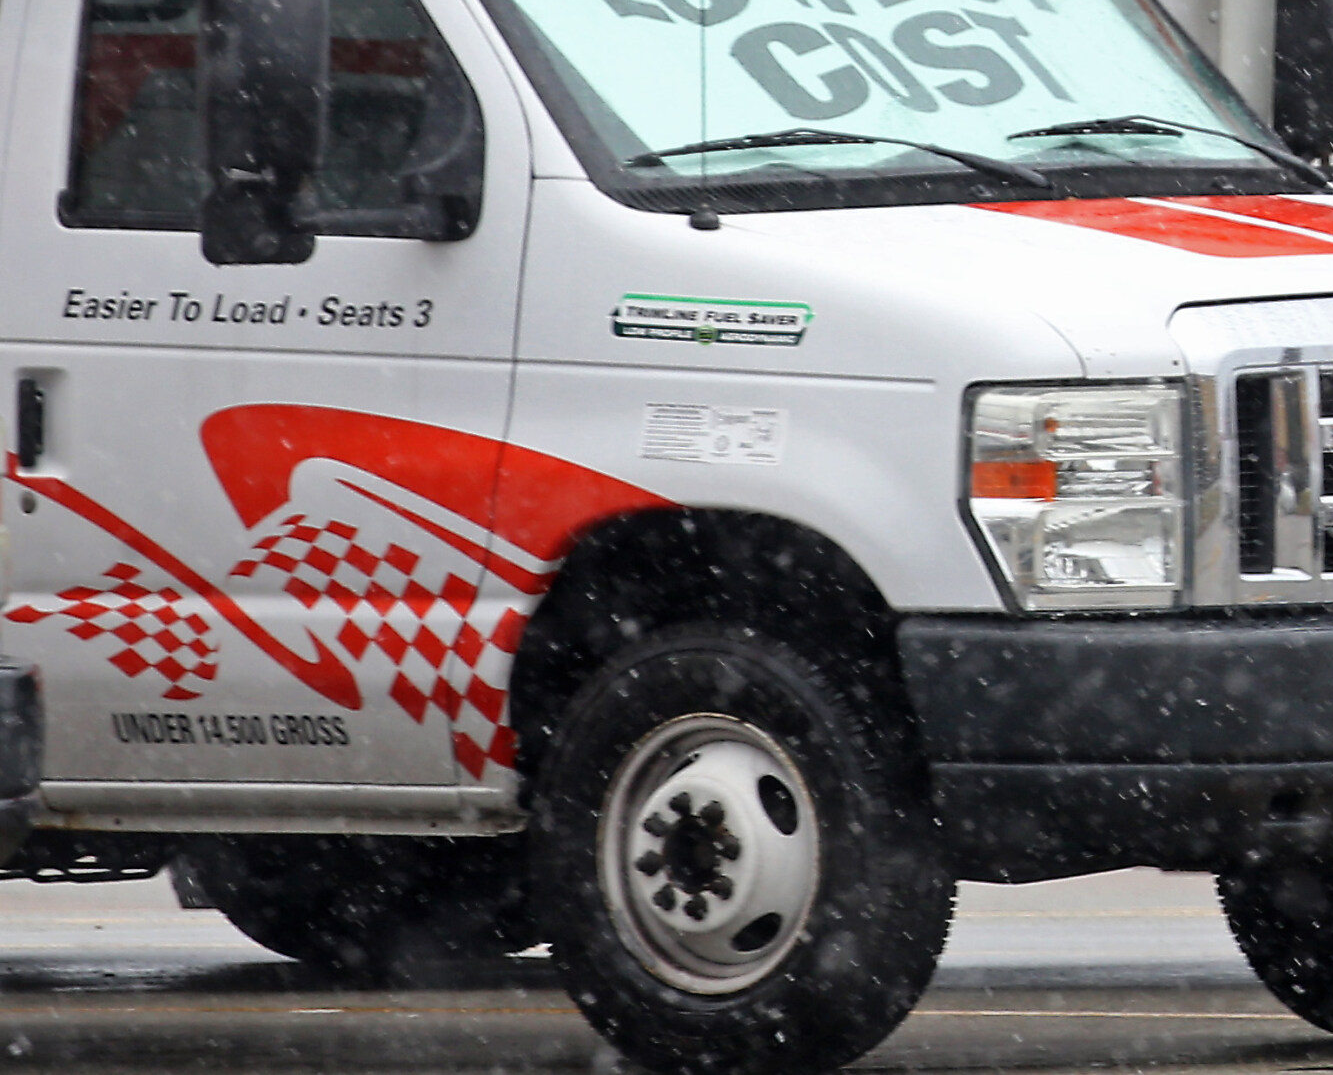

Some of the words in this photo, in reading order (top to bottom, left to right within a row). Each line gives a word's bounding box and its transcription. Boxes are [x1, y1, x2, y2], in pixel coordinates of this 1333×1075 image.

[730, 10, 1075, 122] COST
[62, 288, 158, 321] Easier
[169, 291, 202, 323] To
[211, 292, 292, 325] Load
[316, 294, 405, 327] Seats
[413, 298, 434, 328] 3
[704, 310, 742, 324] FUEL
[112, 713, 197, 744] UNDER
[199, 715, 268, 746] 14,500
[270, 714, 350, 746] GROSS
